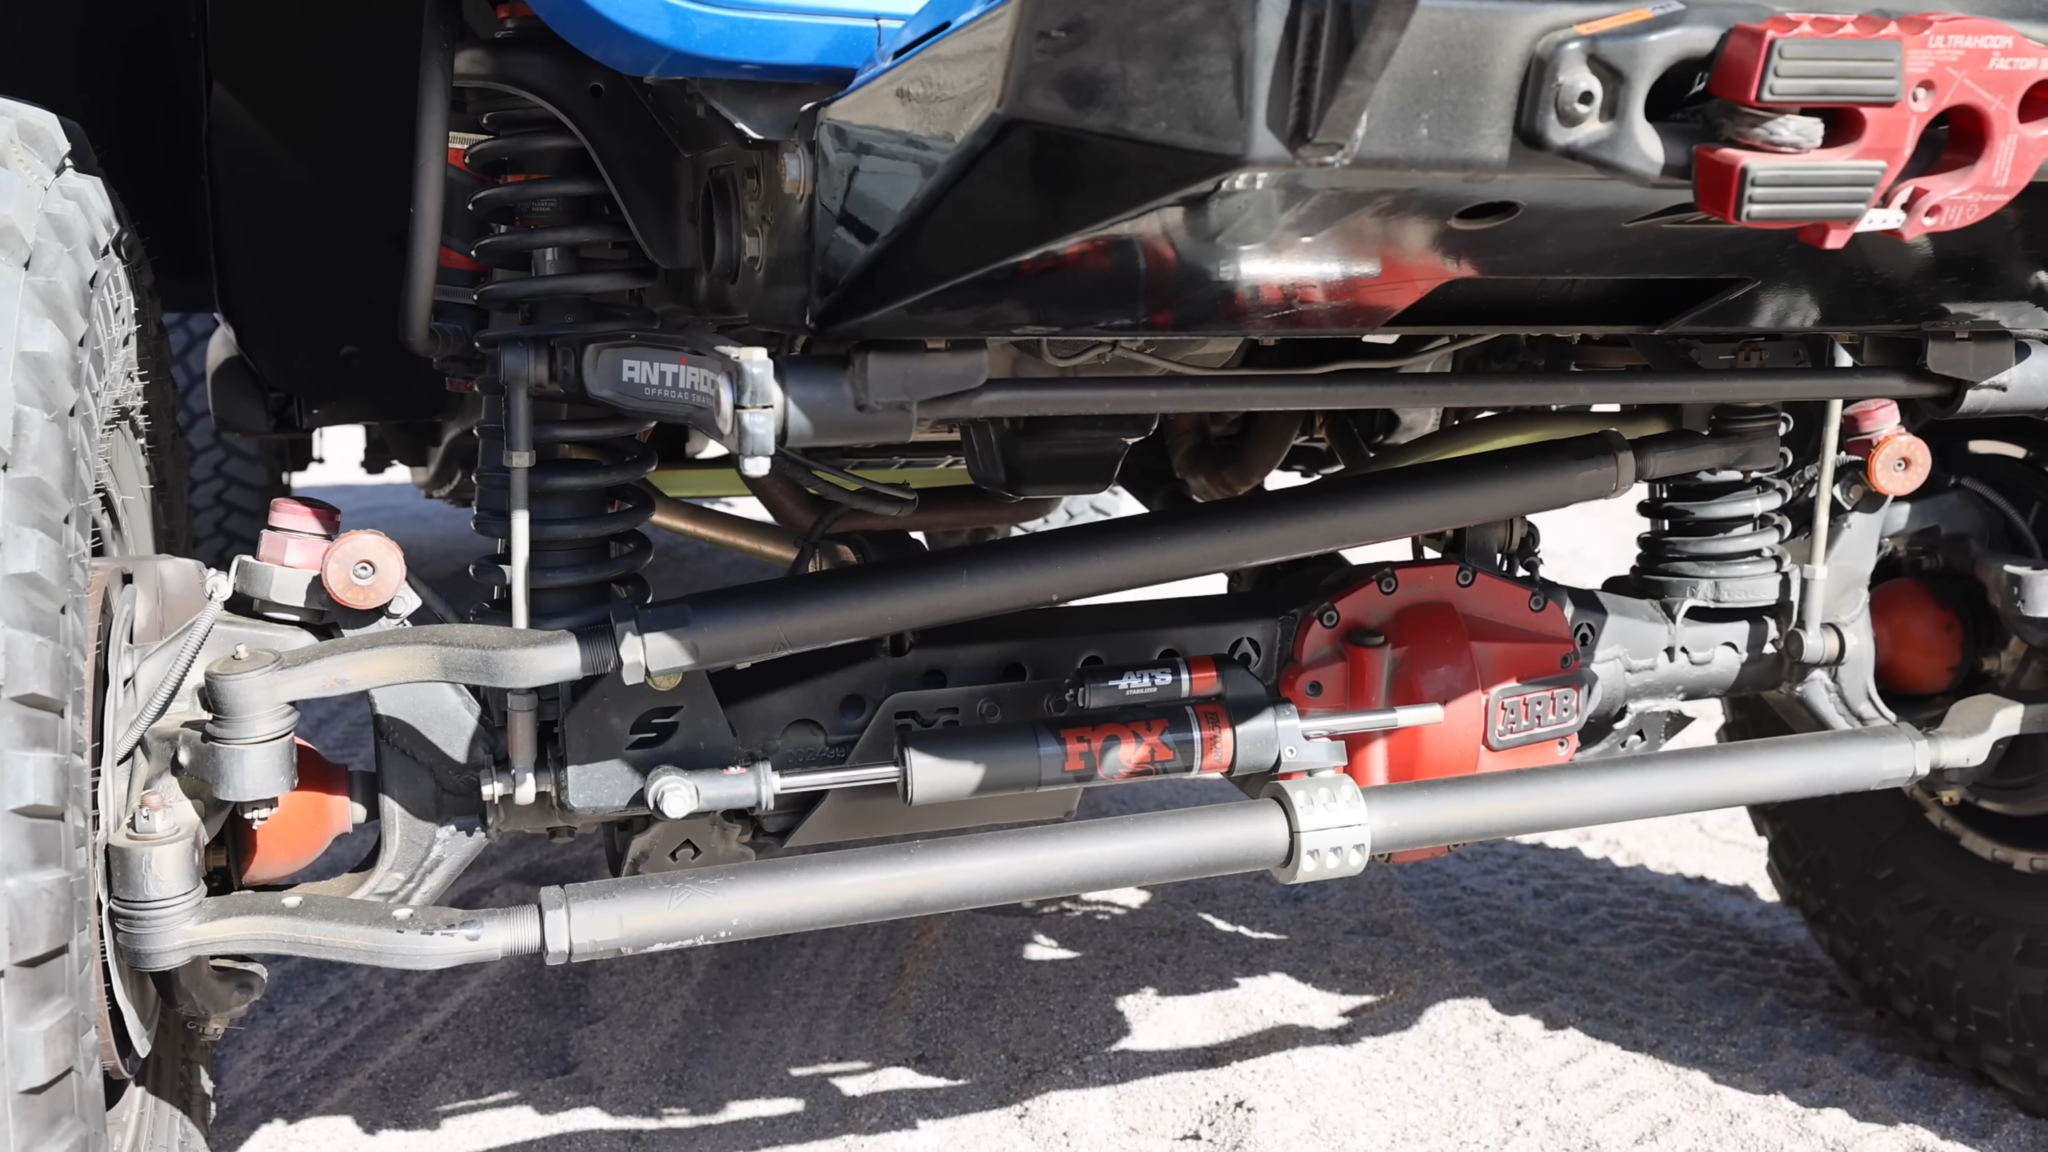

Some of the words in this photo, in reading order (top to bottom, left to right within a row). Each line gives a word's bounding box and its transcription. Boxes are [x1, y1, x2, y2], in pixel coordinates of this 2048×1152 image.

[1927, 34, 2014, 49] ULTRAHOOK
[1988, 57, 2039, 70] FACTOR
[622, 356, 718, 397] ANTIROC
[644, 387, 690, 400] OFFROAD
[1108, 667, 1172, 689] ATS
[1125, 687, 1158, 696] STABILIZER
[1498, 690, 1576, 735] ARB
[1059, 718, 1175, 776] FOX
[1207, 711, 1223, 765] FACTORY
